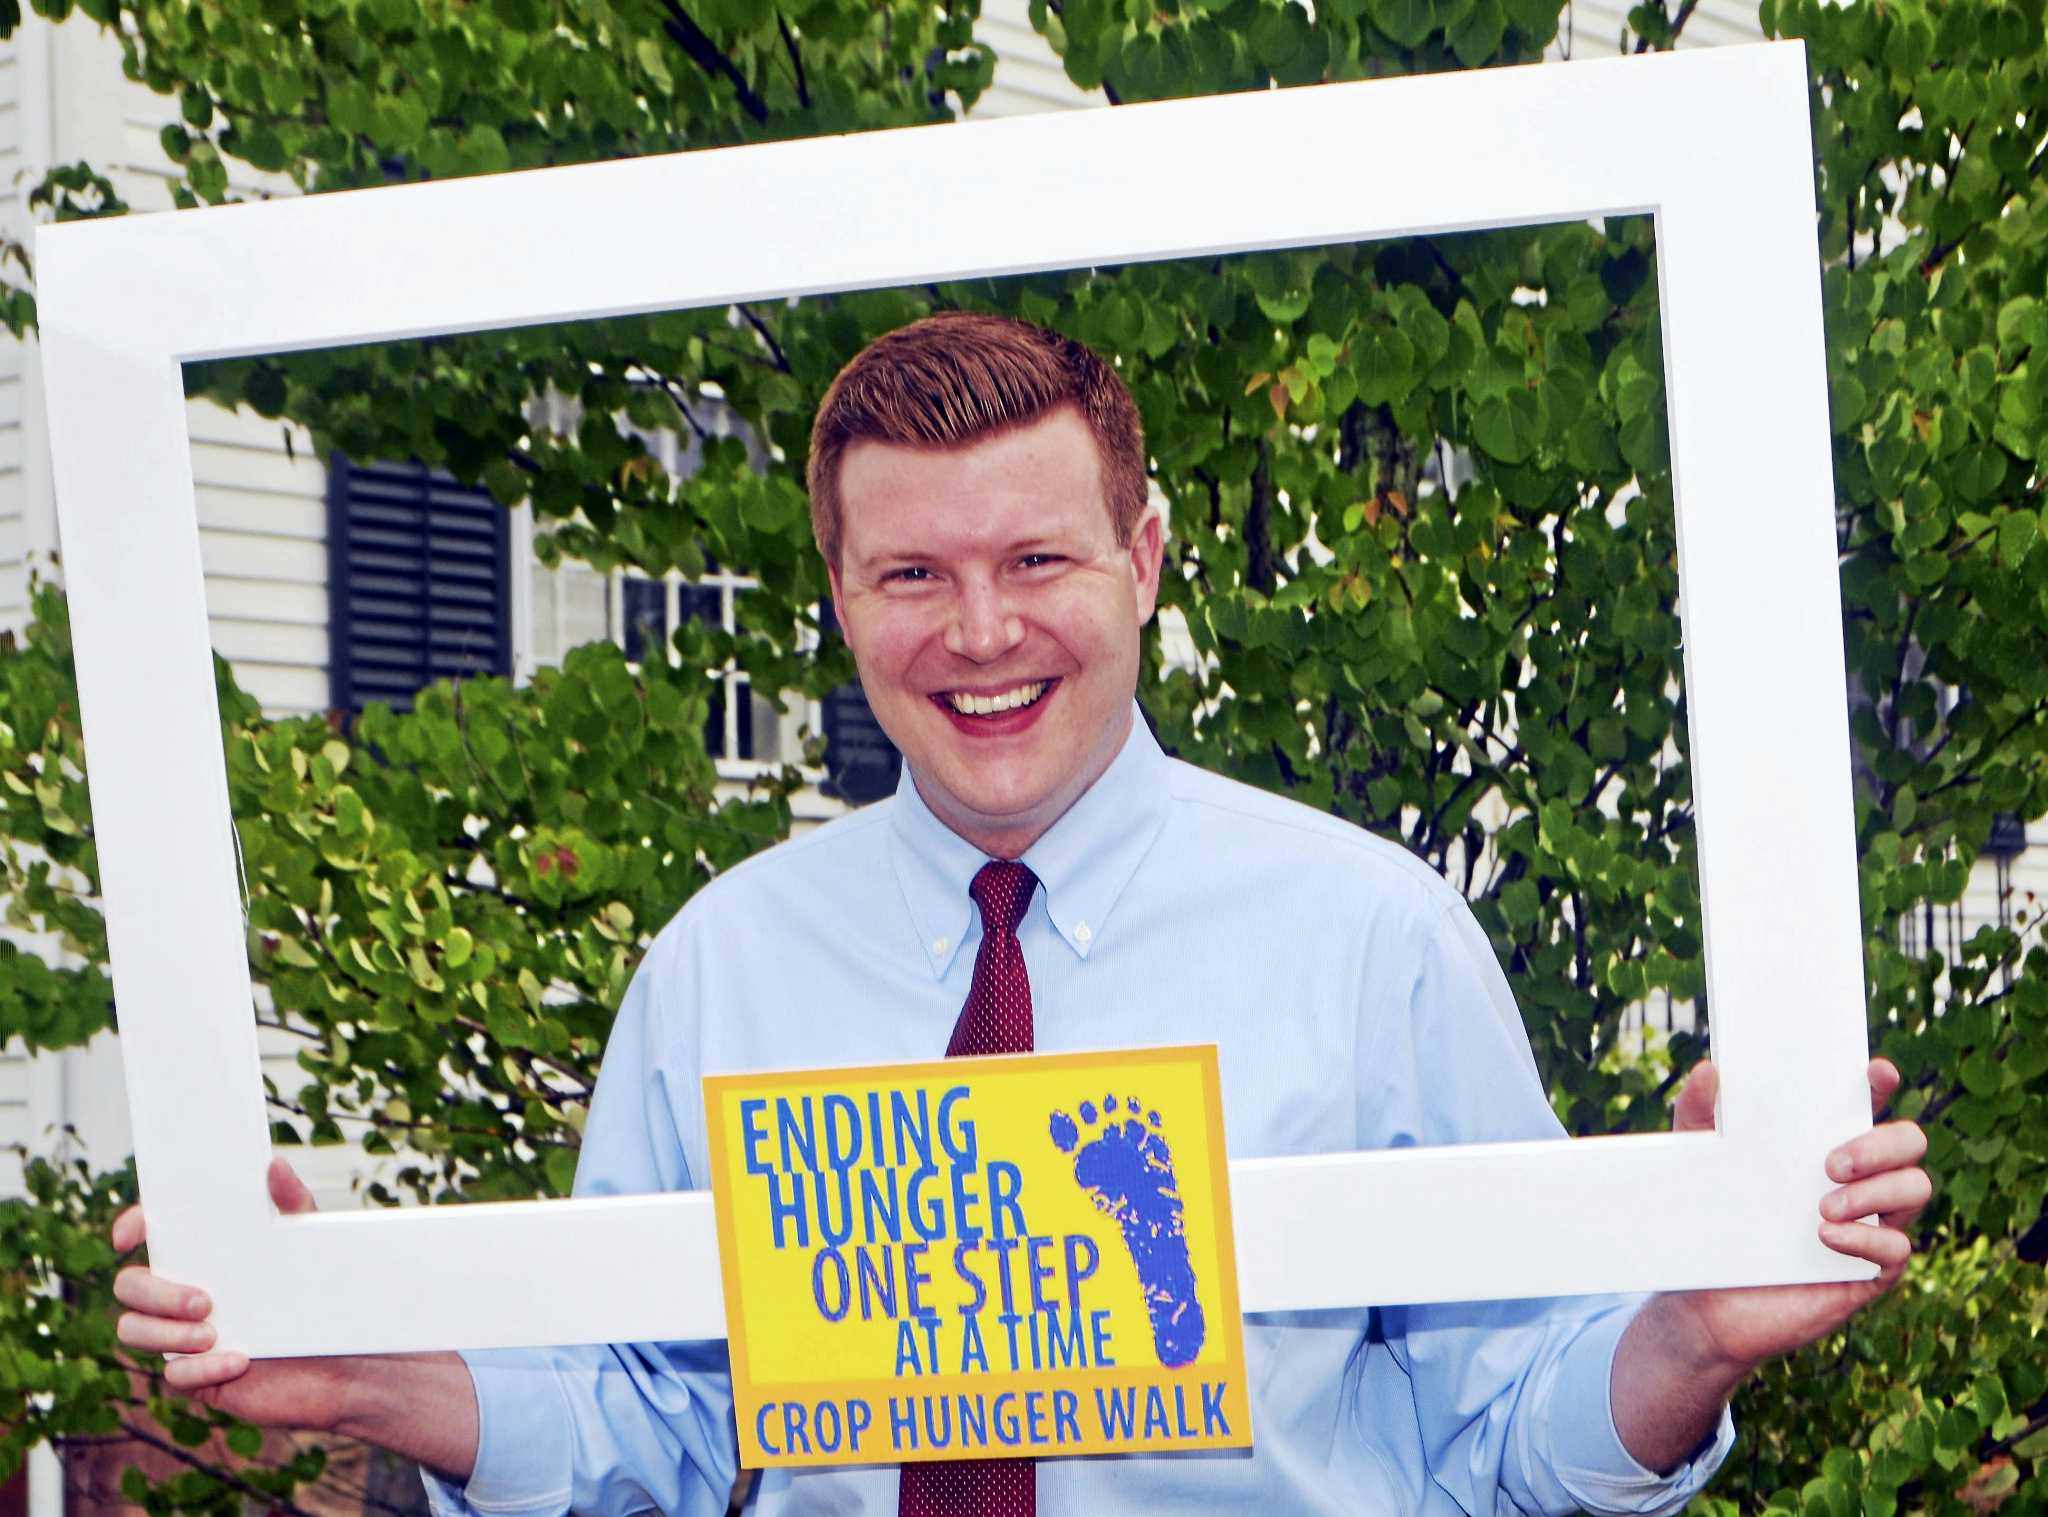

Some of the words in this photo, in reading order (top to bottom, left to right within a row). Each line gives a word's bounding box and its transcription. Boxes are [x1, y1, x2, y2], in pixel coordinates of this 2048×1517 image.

[739, 1086, 978, 1175] ENDING
[767, 1161, 1029, 1248] HUNGER
[812, 1242, 937, 1322] ONE
[953, 1235, 1099, 1318] STEP
[895, 1317, 942, 1377] AT
[960, 1315, 989, 1373] A
[998, 1310, 1116, 1371] TIME
[756, 1399, 872, 1456] CROP
[889, 1390, 1082, 1449] HUNGER
[1094, 1382, 1232, 1440] WALK
